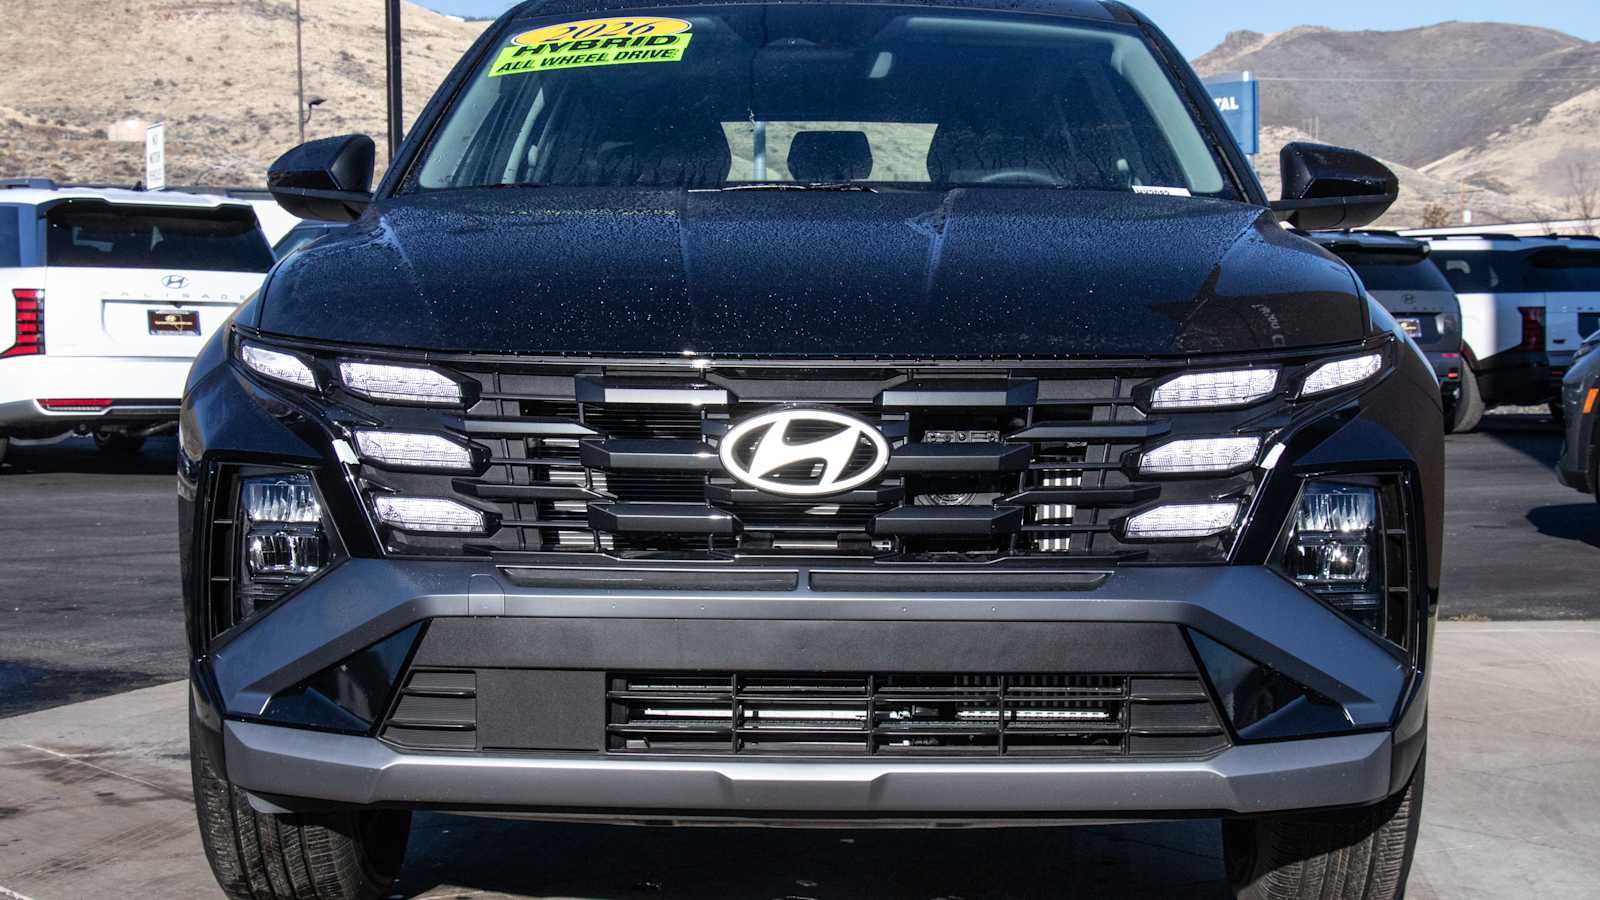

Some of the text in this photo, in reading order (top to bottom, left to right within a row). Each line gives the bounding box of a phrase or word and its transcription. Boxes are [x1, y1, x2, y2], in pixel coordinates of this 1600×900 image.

[544, 21, 657, 42] 2026
[513, 35, 677, 57] HYBRID
[497, 48, 678, 72] ALL WHEEL DRIVE
